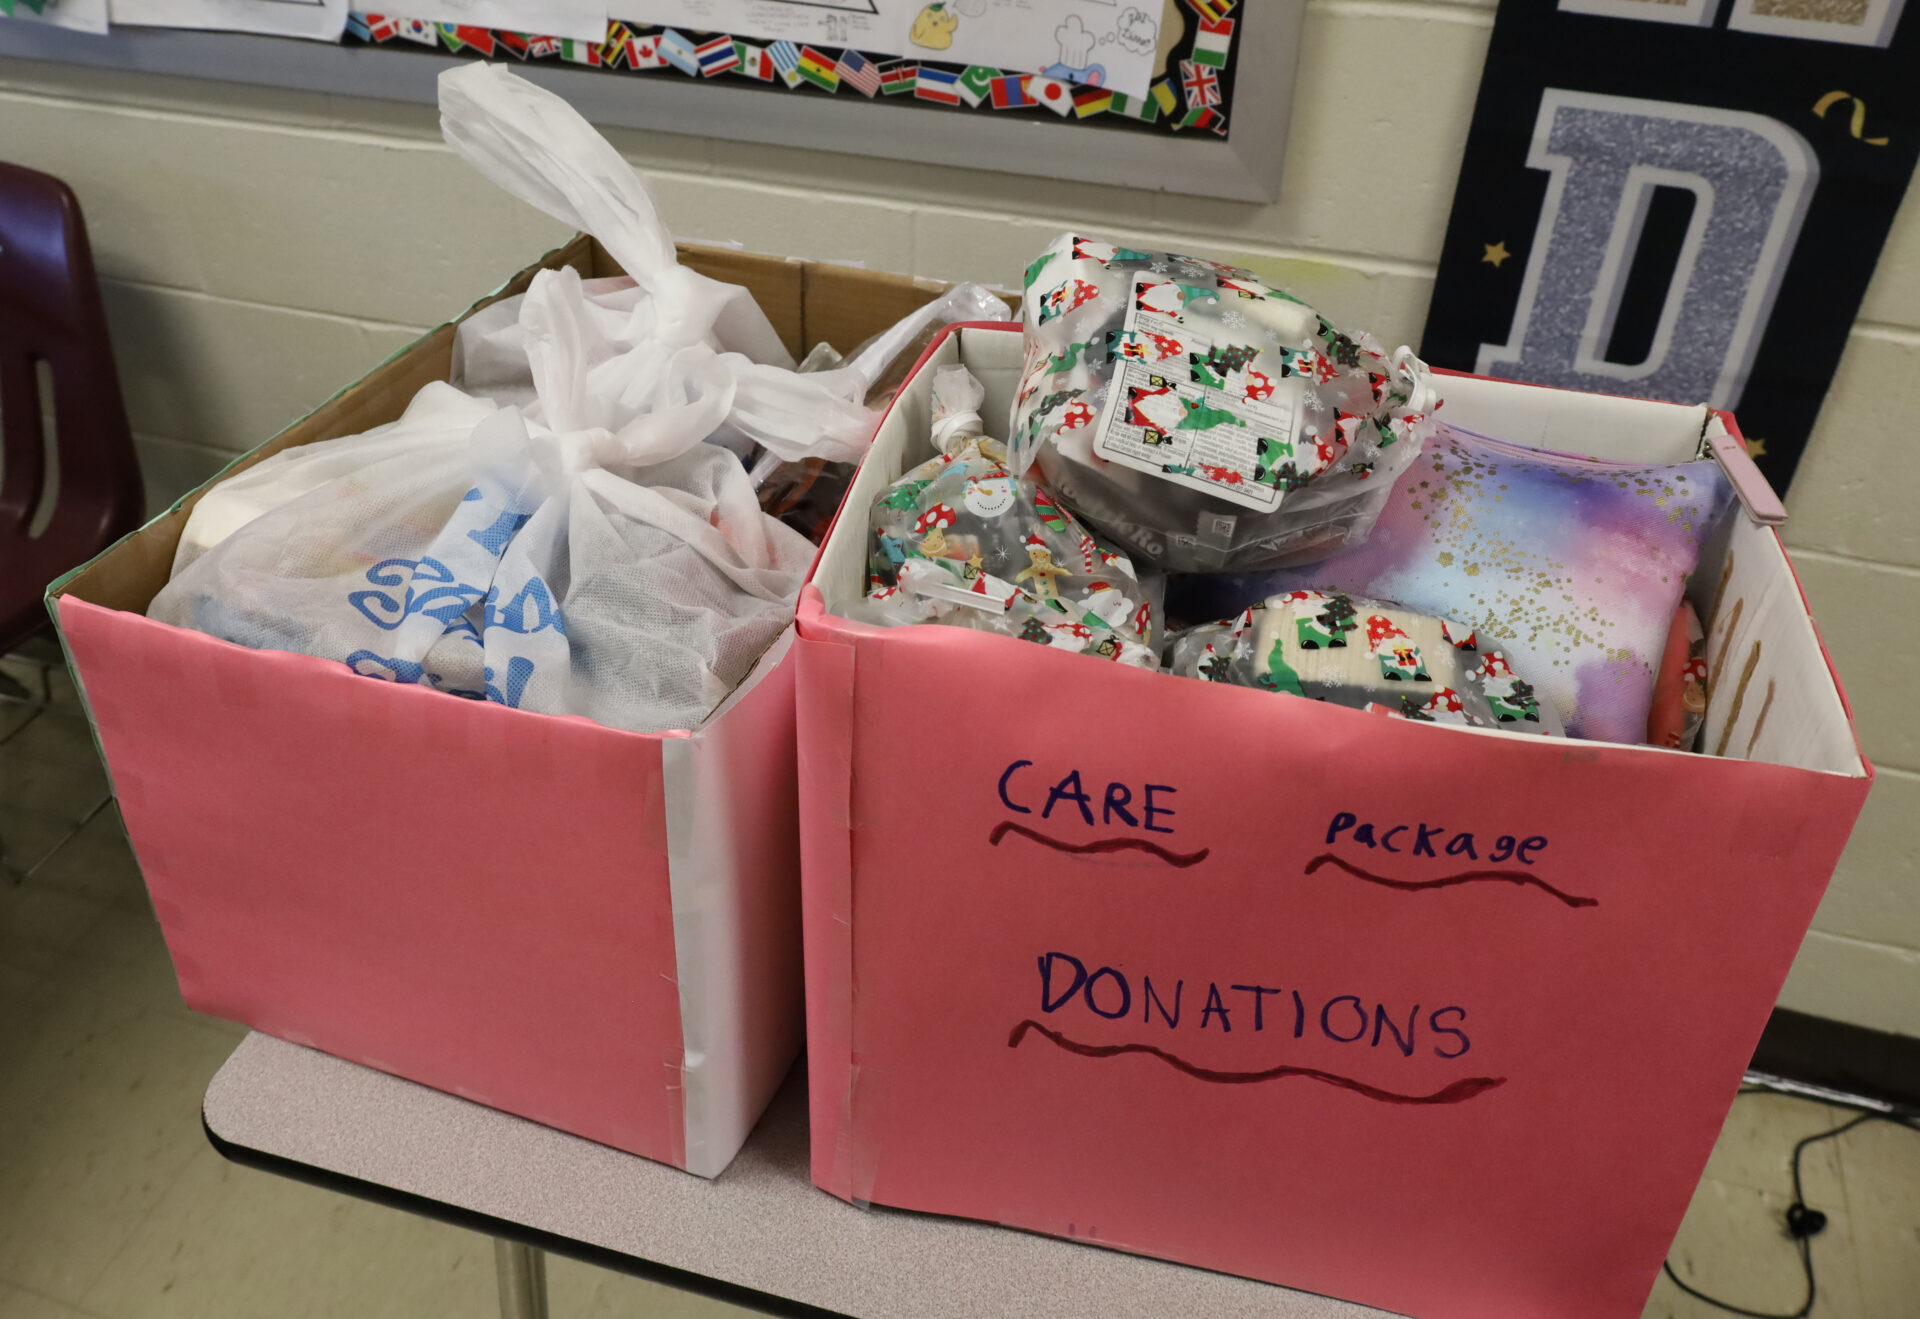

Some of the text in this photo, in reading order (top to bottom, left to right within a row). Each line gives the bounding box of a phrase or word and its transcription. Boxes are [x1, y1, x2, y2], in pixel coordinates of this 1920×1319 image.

[1474, 87, 1821, 412] D
[999, 760, 1178, 833] CARE
[1038, 952, 1471, 1058] DONATIONS
